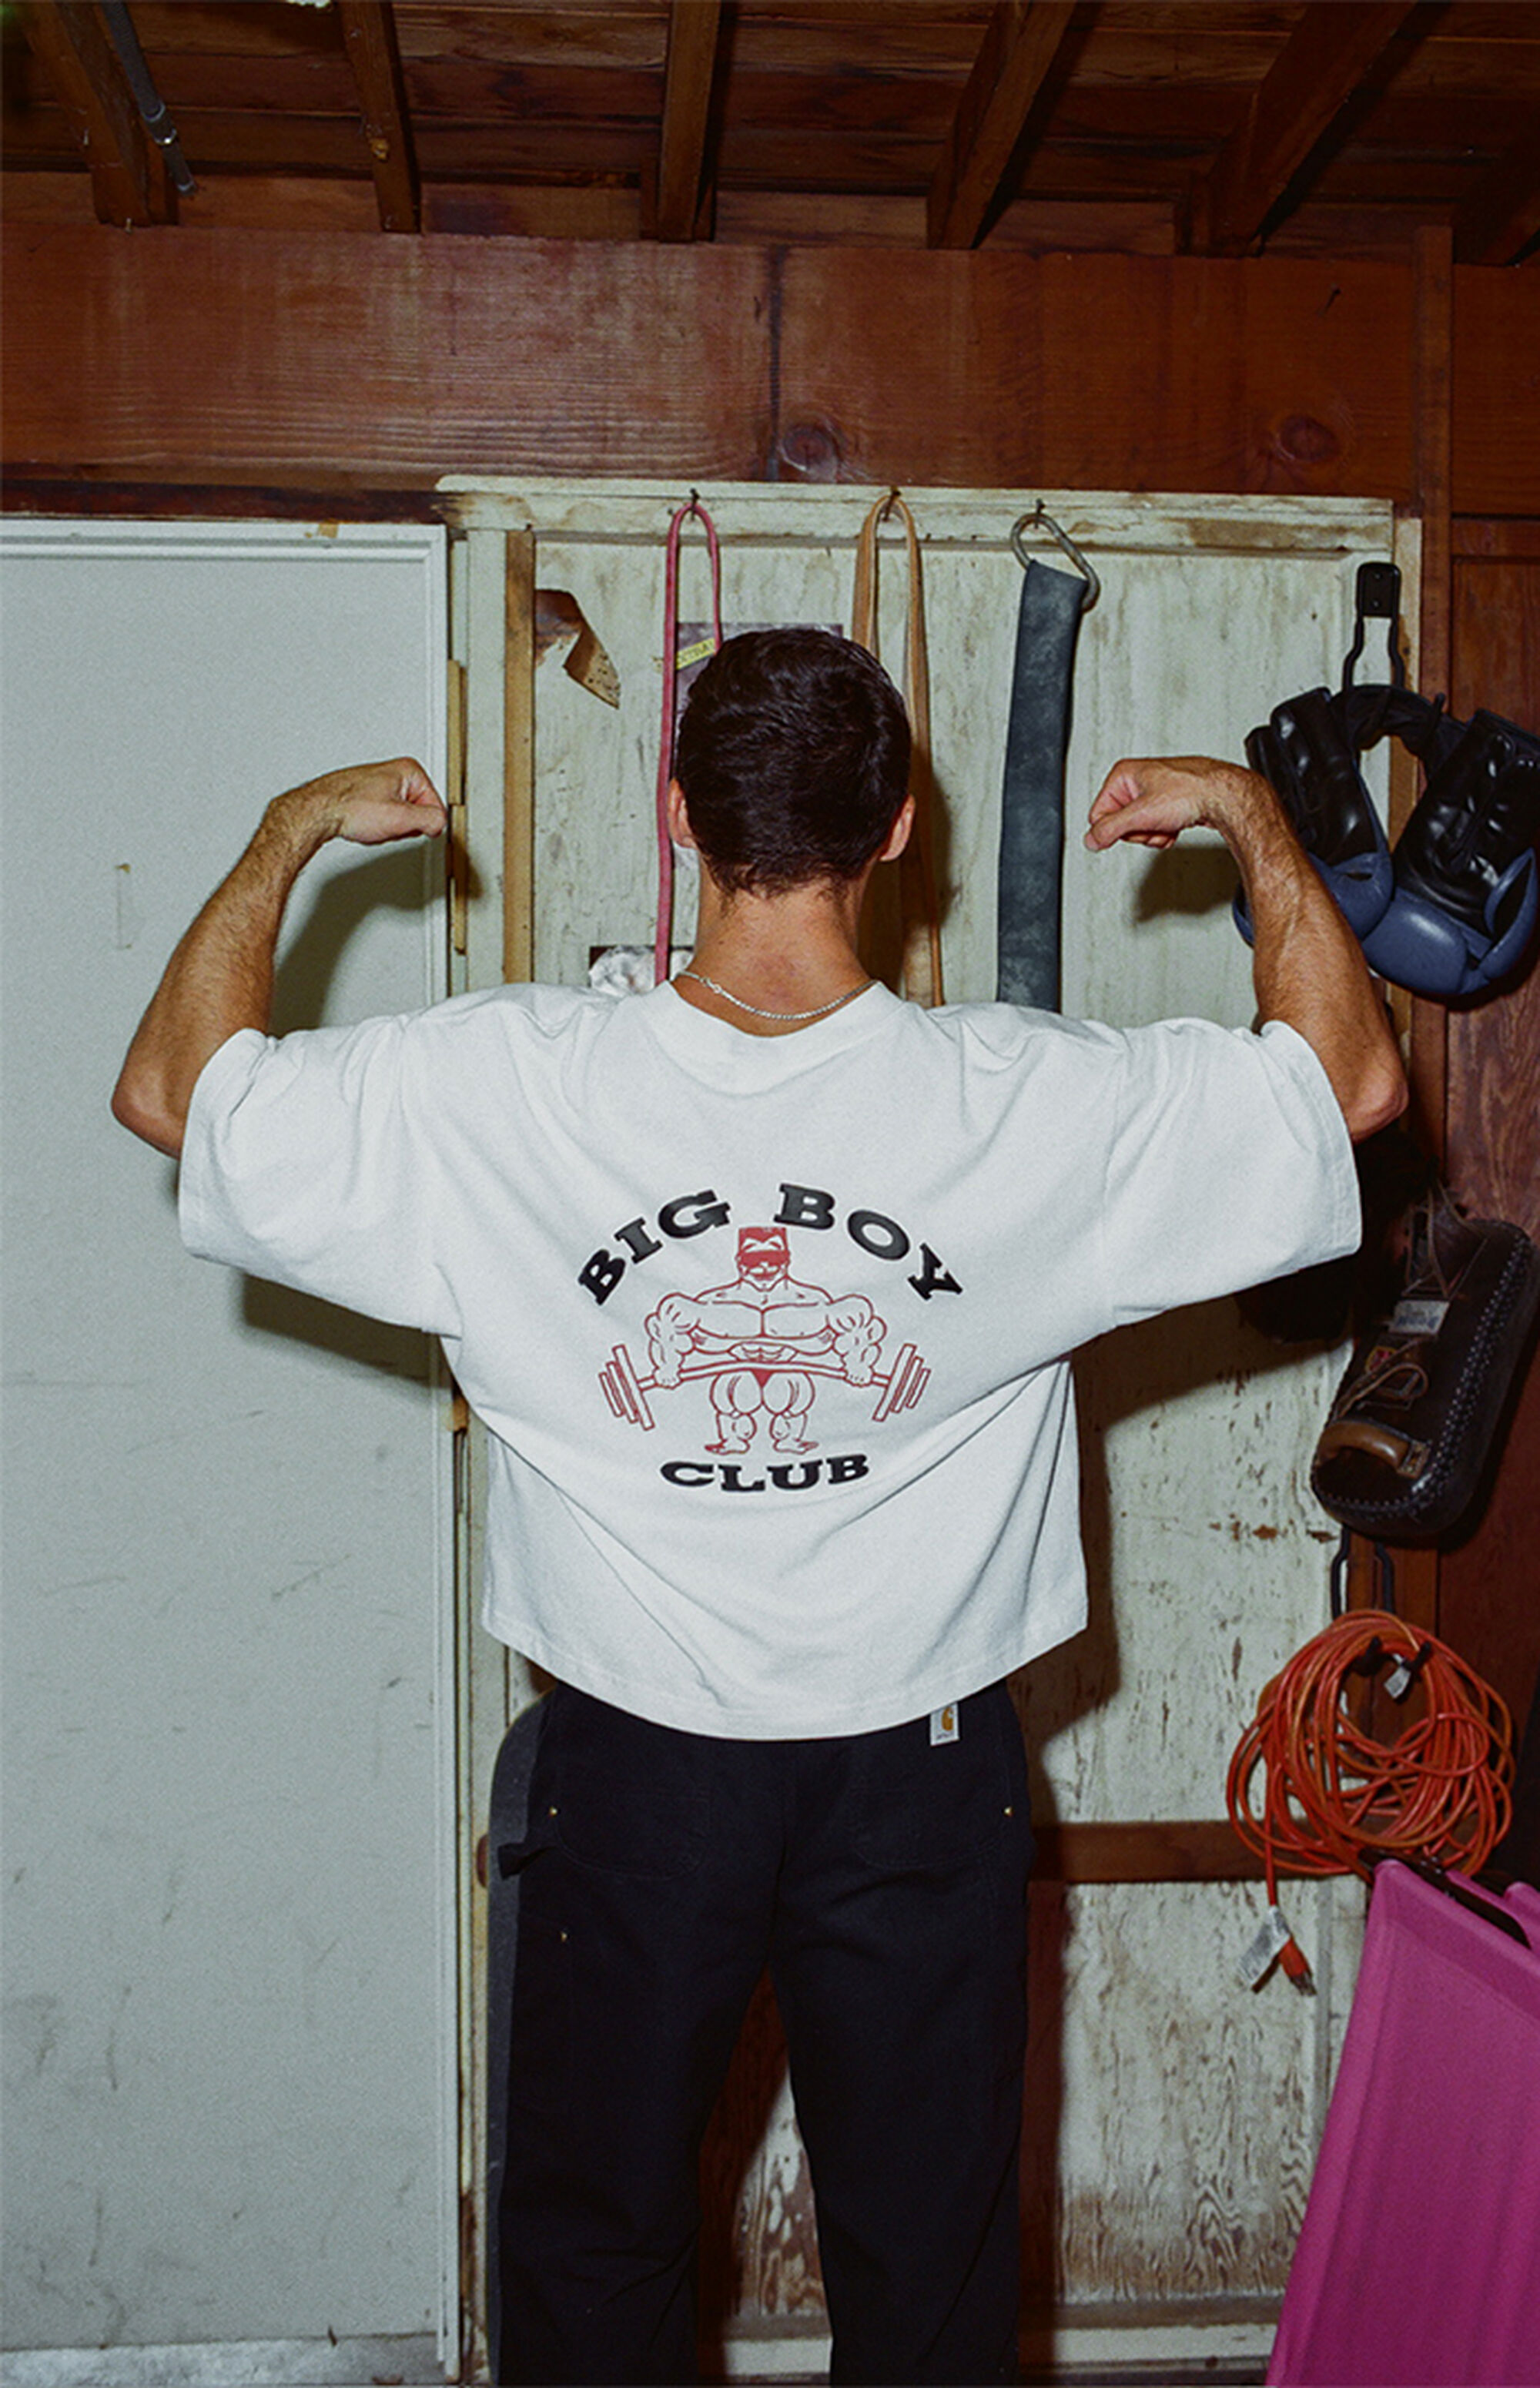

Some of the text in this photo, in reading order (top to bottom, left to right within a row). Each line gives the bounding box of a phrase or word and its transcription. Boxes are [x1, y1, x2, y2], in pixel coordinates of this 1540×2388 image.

[578, 1183, 963, 1305] BIG BOY
[660, 1454, 869, 1492] CLUB
